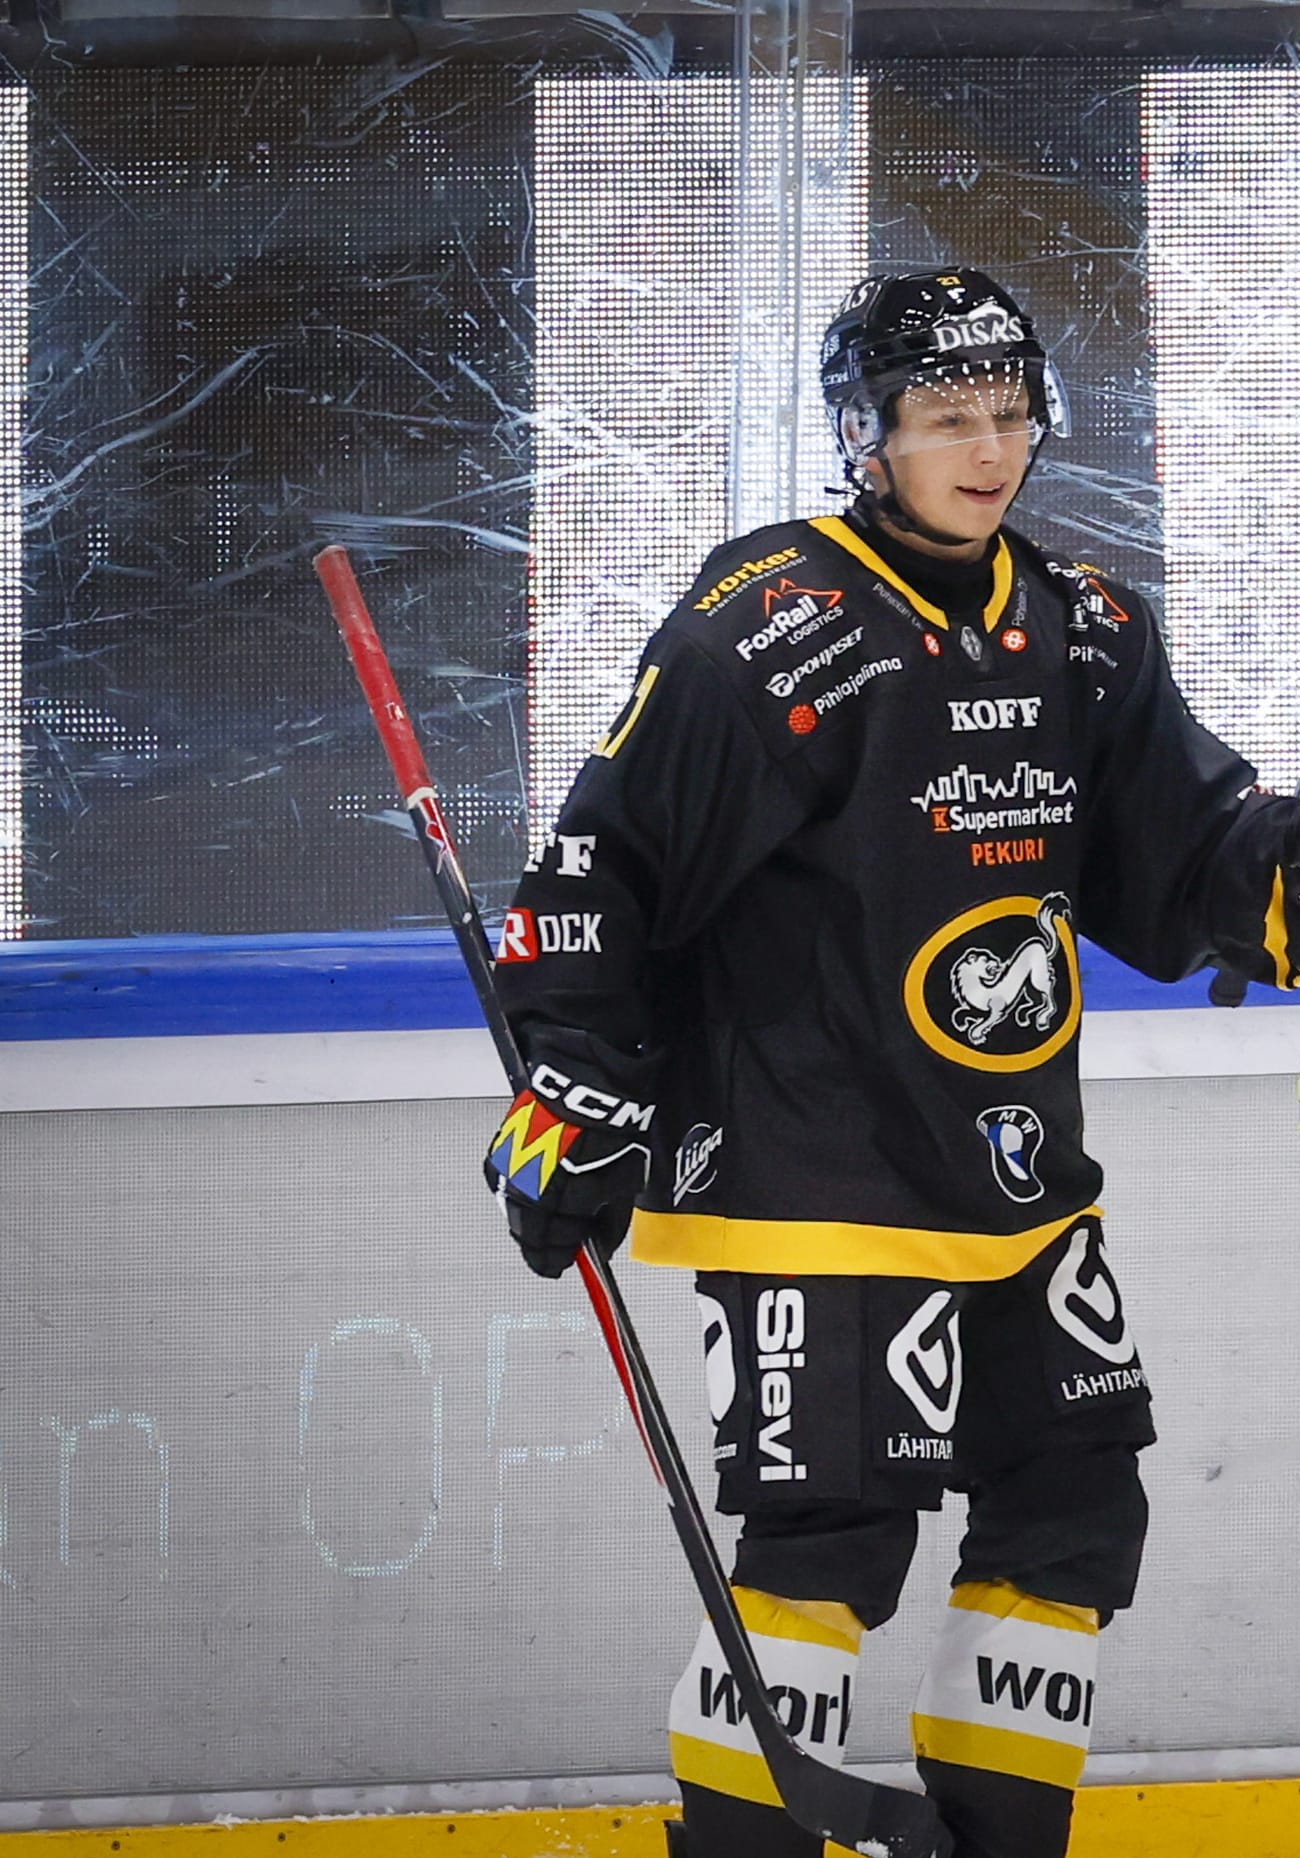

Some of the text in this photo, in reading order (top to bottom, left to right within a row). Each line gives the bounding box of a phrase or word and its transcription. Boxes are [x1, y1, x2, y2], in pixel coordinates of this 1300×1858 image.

[932, 315, 1026, 353] DISAS
[693, 547, 799, 611] worker
[736, 594, 819, 662] FoxRail
[786, 605, 844, 645] LOGISTICS
[813, 657, 903, 716] Pihlajalinna
[947, 696, 1043, 732] KOFF
[949, 800, 1074, 835] Supermarket
[969, 837, 1045, 867] PEKURI
[531, 1063, 656, 1132] CCM
[756, 1287, 808, 1482] Sievi
